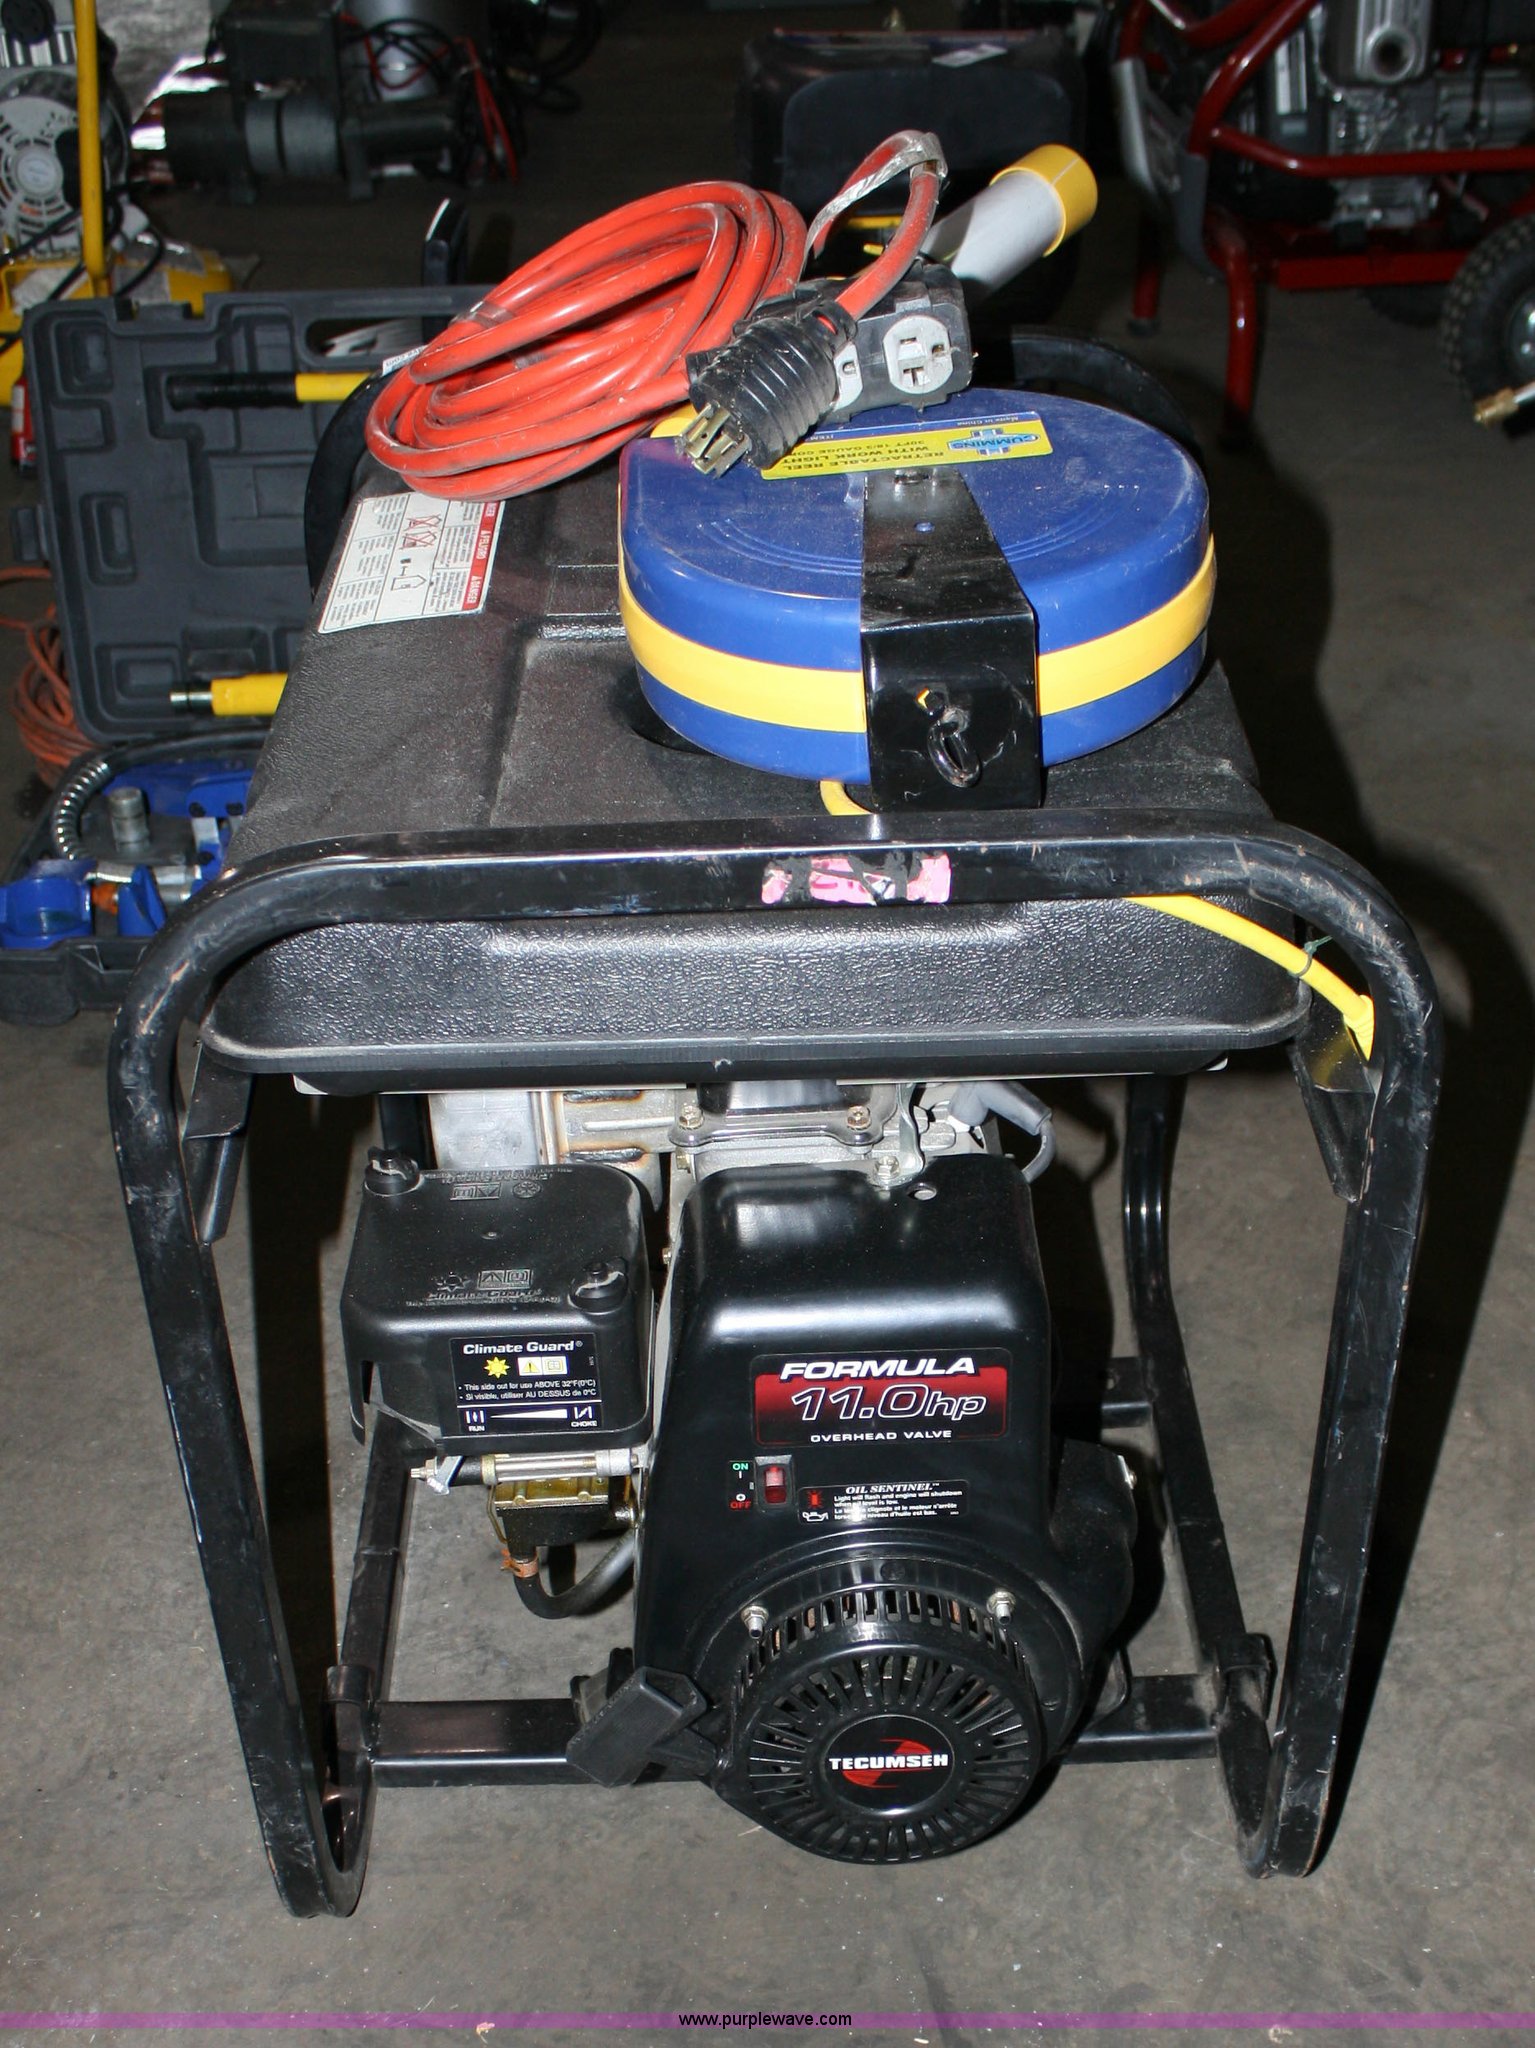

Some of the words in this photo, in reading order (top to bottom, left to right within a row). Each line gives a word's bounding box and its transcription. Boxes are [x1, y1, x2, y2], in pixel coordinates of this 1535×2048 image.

[952, 435, 1039, 449] CUMMINS
[818, 446, 862, 454] GAUGE
[887, 446, 929, 454] WITH
[781, 455, 829, 464] LIGHT
[829, 451, 944, 467] RETRACTABLE
[834, 450, 882, 461] WORK
[783, 463, 824, 471] REEL
[467, 580, 481, 604] DANGER
[463, 1341, 523, 1355] Climate
[780, 1357, 975, 1380] FORMULA
[464, 1383, 480, 1391] This
[465, 1393, 474, 1401] Si
[538, 1390, 571, 1398] DESSUS
[570, 1420, 598, 1428] CHOKE
[810, 1431, 898, 1443] OVERHEAD
[904, 1430, 952, 1439] VALVE
[732, 1463, 749, 1471] ON
[846, 1486, 868, 1494] OIL
[834, 1496, 851, 1504] Light
[730, 1501, 751, 1510] OFF
[829, 1753, 949, 1770] TECUMSEH
